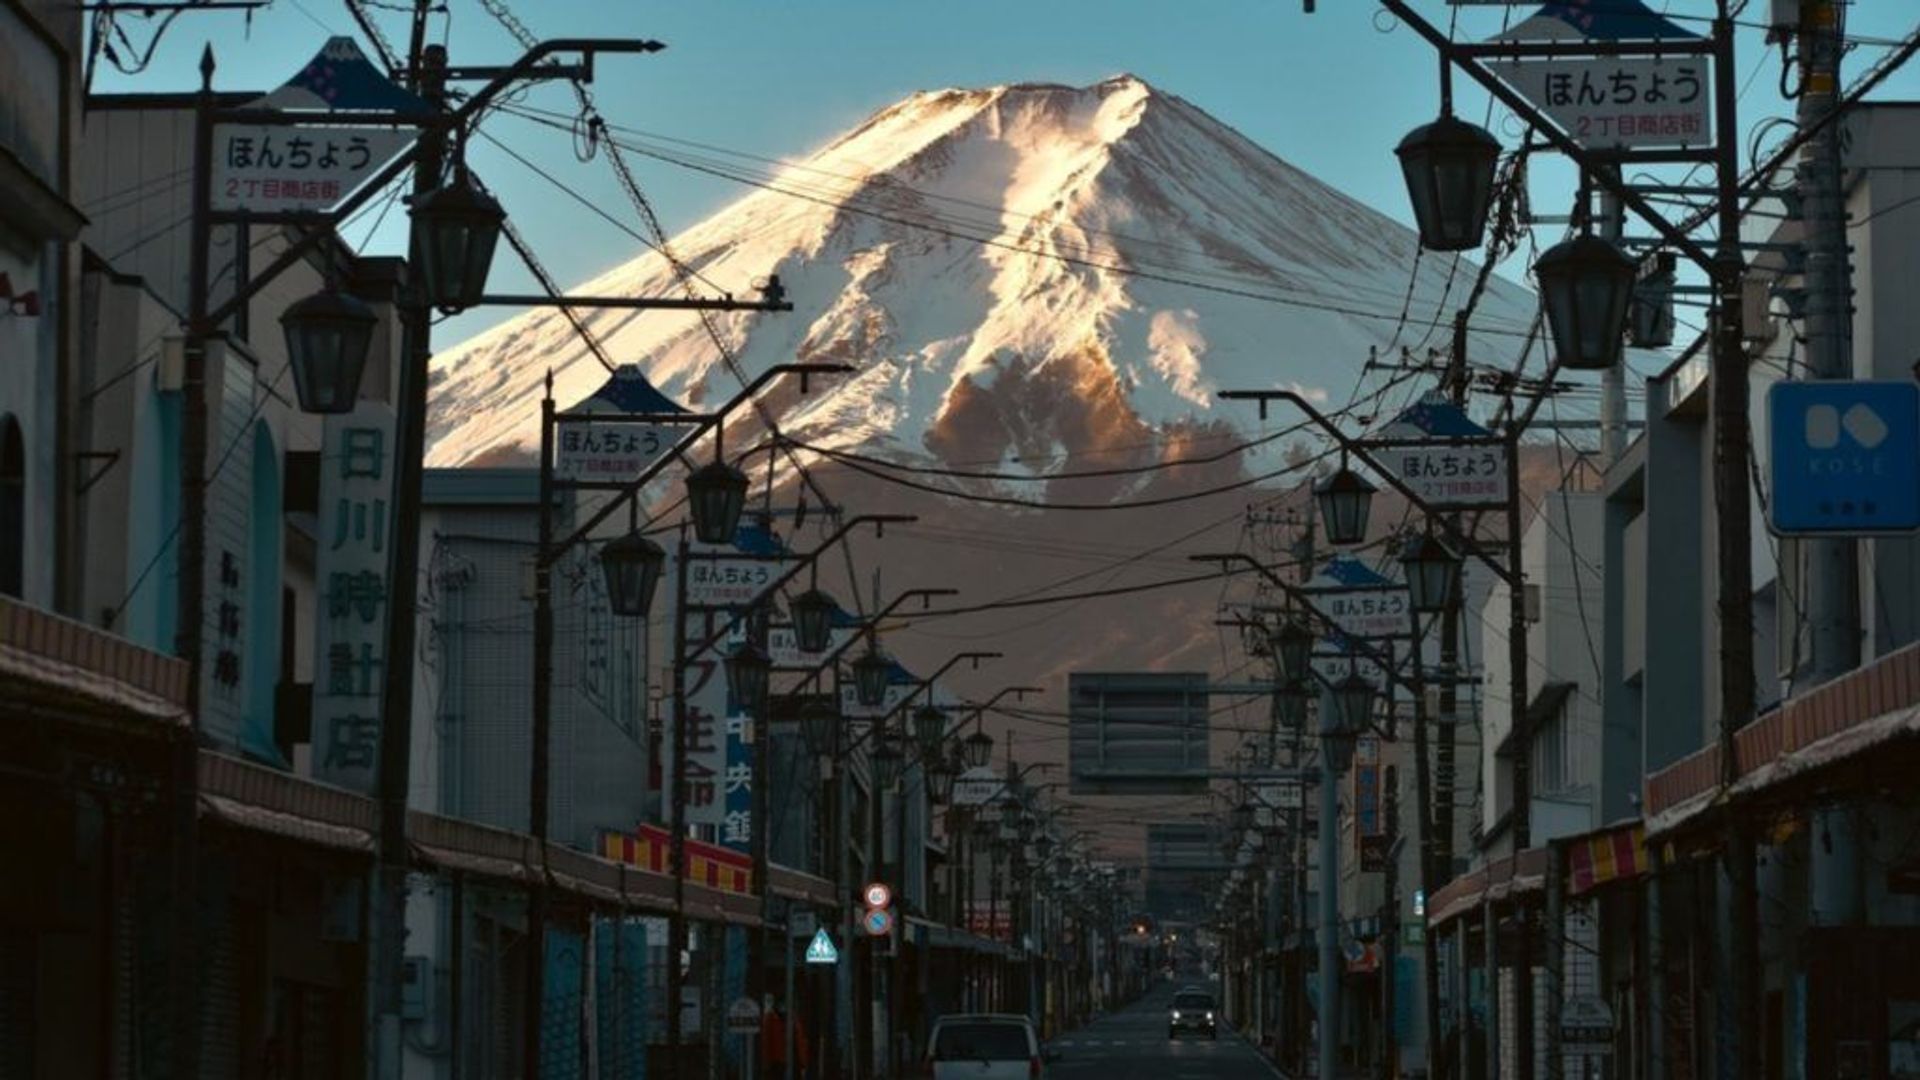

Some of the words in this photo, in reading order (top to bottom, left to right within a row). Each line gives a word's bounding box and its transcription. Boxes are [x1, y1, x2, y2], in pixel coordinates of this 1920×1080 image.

[1545, 67, 1700, 106] ほんちょう
[1577, 112, 1701, 137] 2丁目商店街
[228, 136, 370, 170] ほんちょう
[225, 179, 341, 200] 2丁目商店街
[563, 431, 660, 455] ほんちょう
[1403, 453, 1497, 478] ほんちょう
[693, 566, 769, 585] ほんちょう
[1333, 596, 1403, 615] ほんちょう
